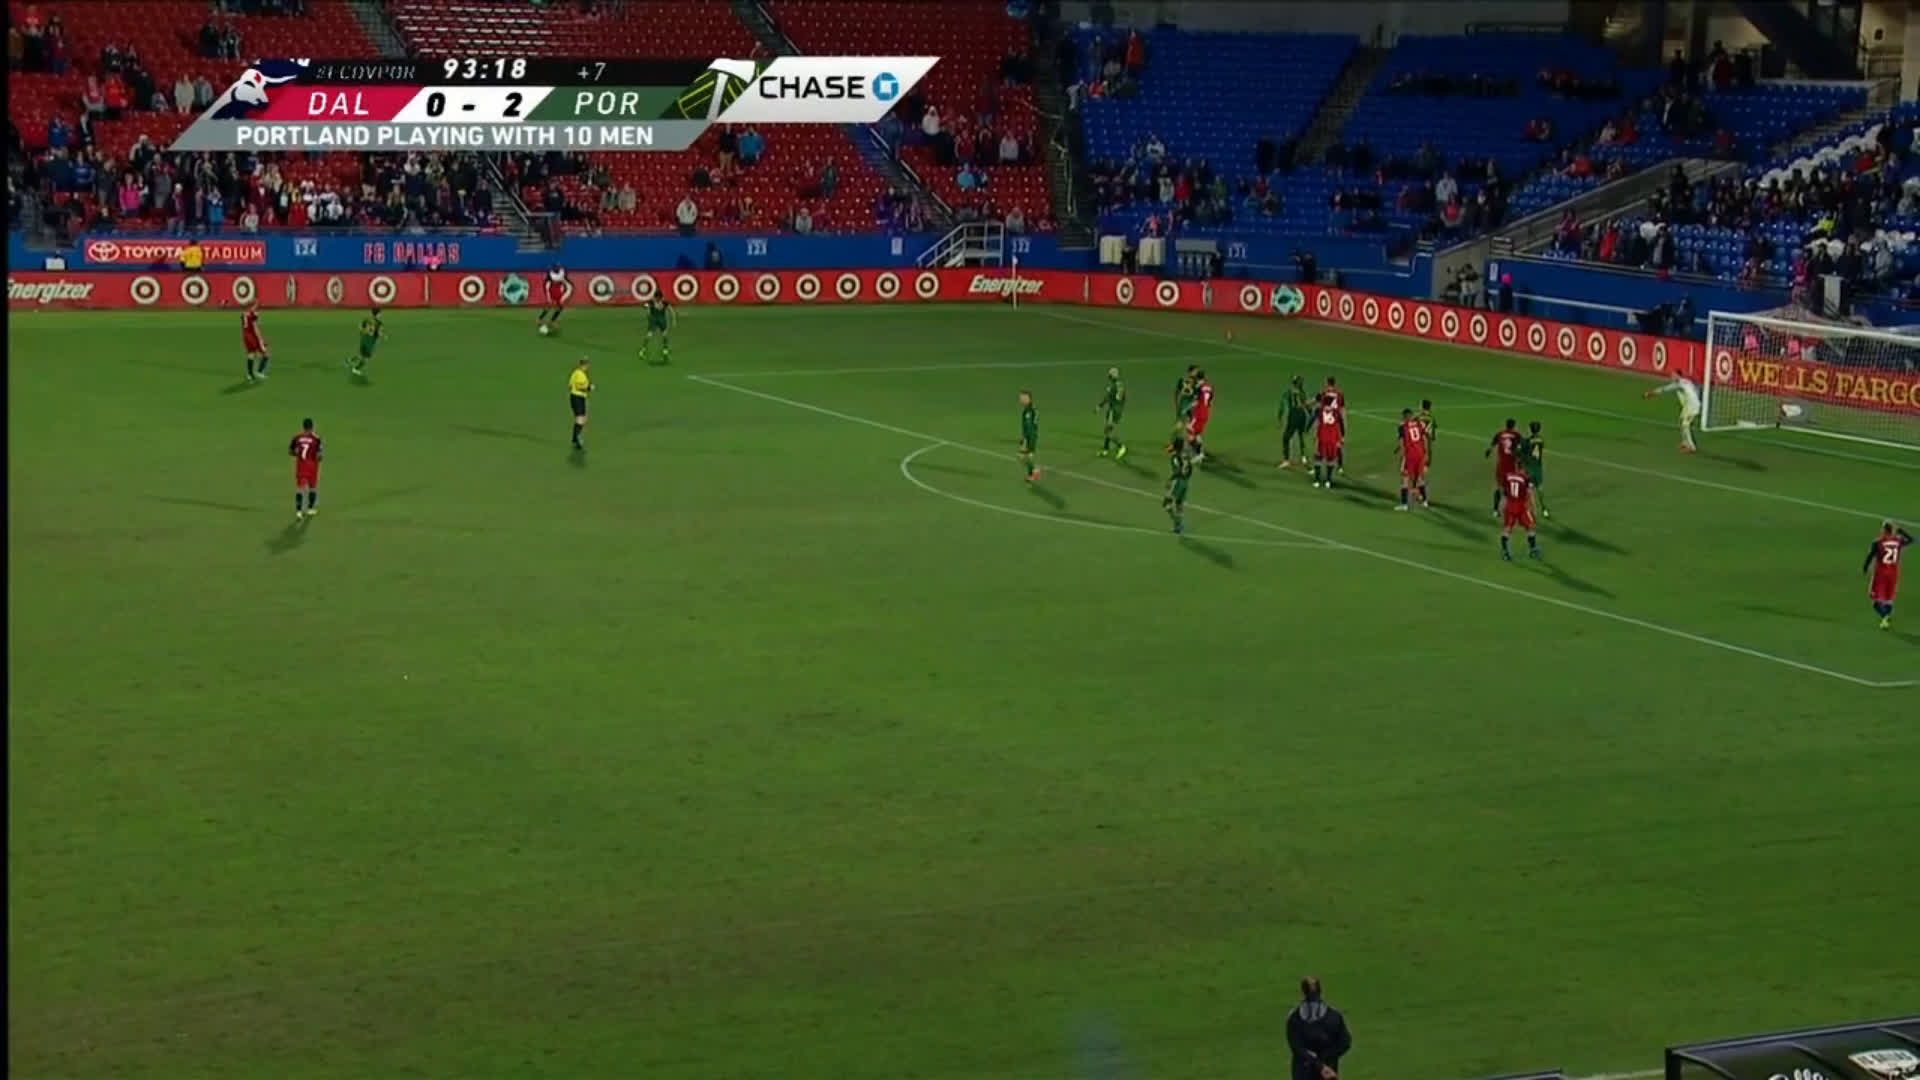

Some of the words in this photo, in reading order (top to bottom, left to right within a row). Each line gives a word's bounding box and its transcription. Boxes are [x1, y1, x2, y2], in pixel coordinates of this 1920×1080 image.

[203, 247, 263, 259] TADIUM
[8, 279, 94, 303] nergizer
[1738, 359, 1828, 395] WELLS
[301, 443, 310, 460] 7
[1882, 547, 1898, 564] 21
